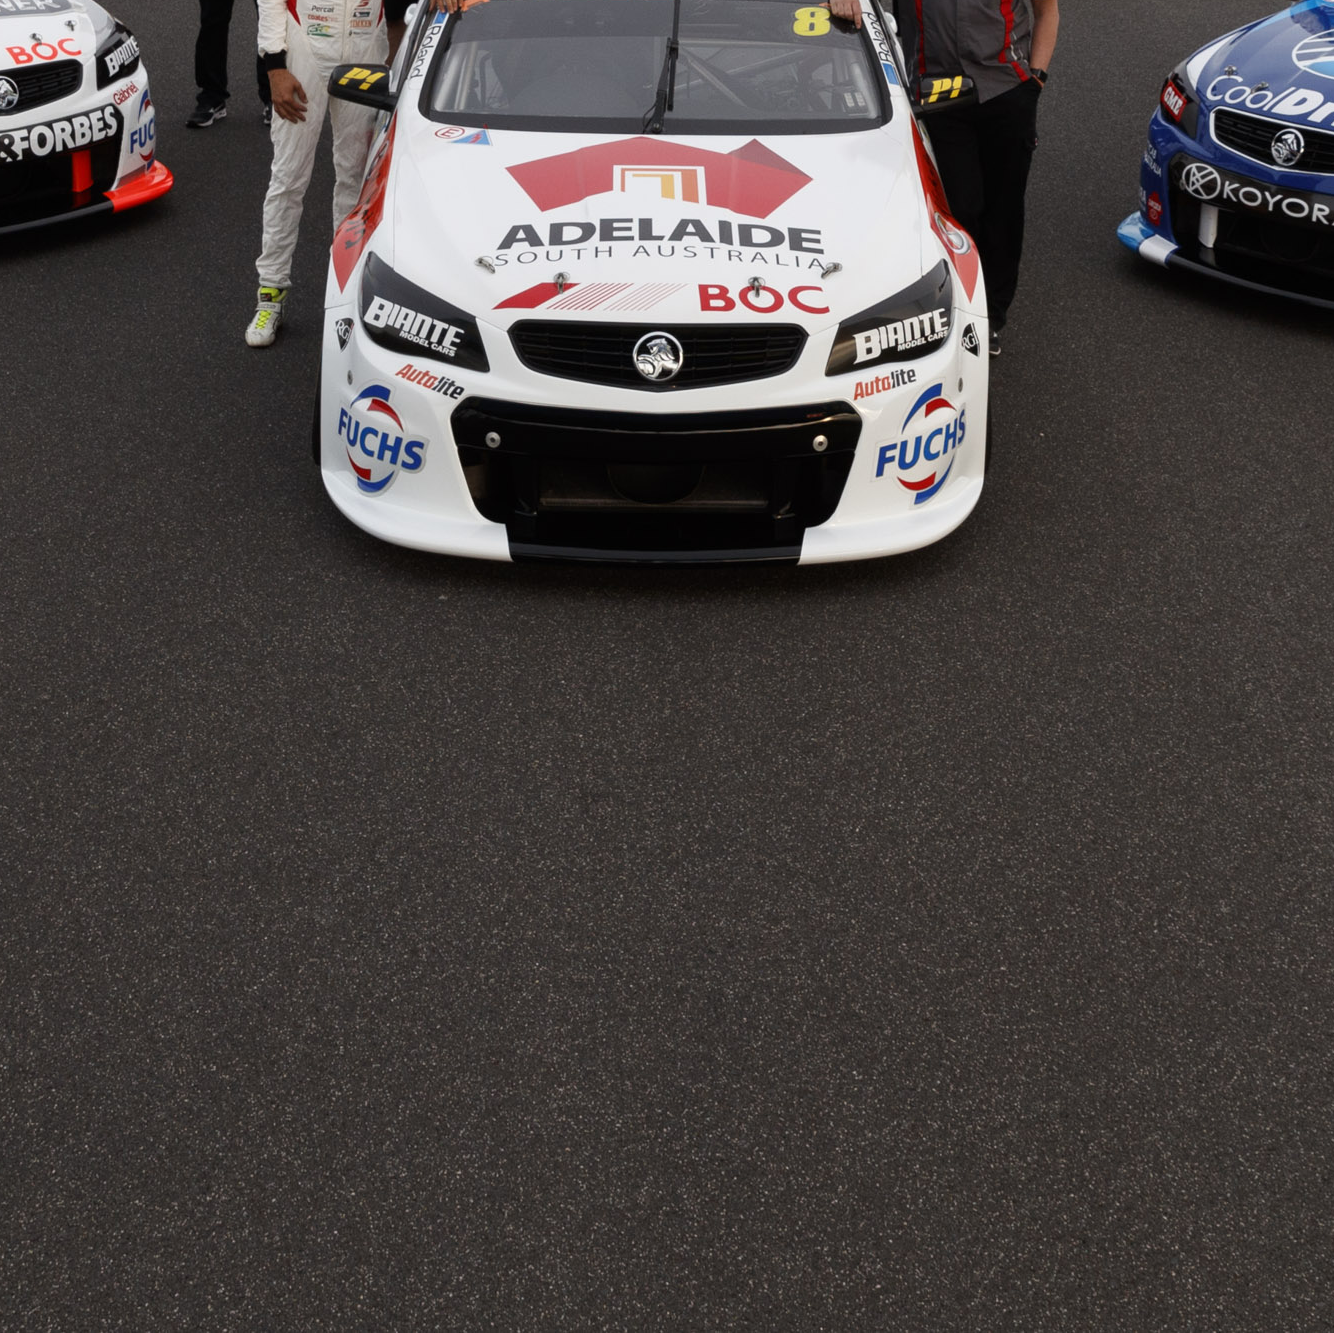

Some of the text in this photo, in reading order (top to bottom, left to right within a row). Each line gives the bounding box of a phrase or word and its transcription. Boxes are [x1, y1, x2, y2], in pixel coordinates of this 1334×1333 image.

[793, 7, 831, 36] 8
[862, 11, 893, 65] Roland
[5, 38, 83, 66] BOC
[409, 25, 442, 79] Roland
[113, 81, 139, 106] Gabriel
[1164, 85, 1183, 116] GME
[129, 118, 155, 154] FUC
[496, 216, 825, 255] ADELAIDE
[494, 242, 825, 271] SOUTH AUSTRALIA
[698, 283, 831, 315] BOC
[363, 294, 465, 352] BIANTE
[852, 307, 949, 365] BIANTE
[897, 329, 949, 352] MODEL CARS
[399, 329, 456, 358] MODEL CARS
[394, 363, 465, 400] Autolite
[853, 367, 917, 401] Autolite
[337, 407, 425, 471] FUCHS
[875, 408, 966, 478] FUCHS
